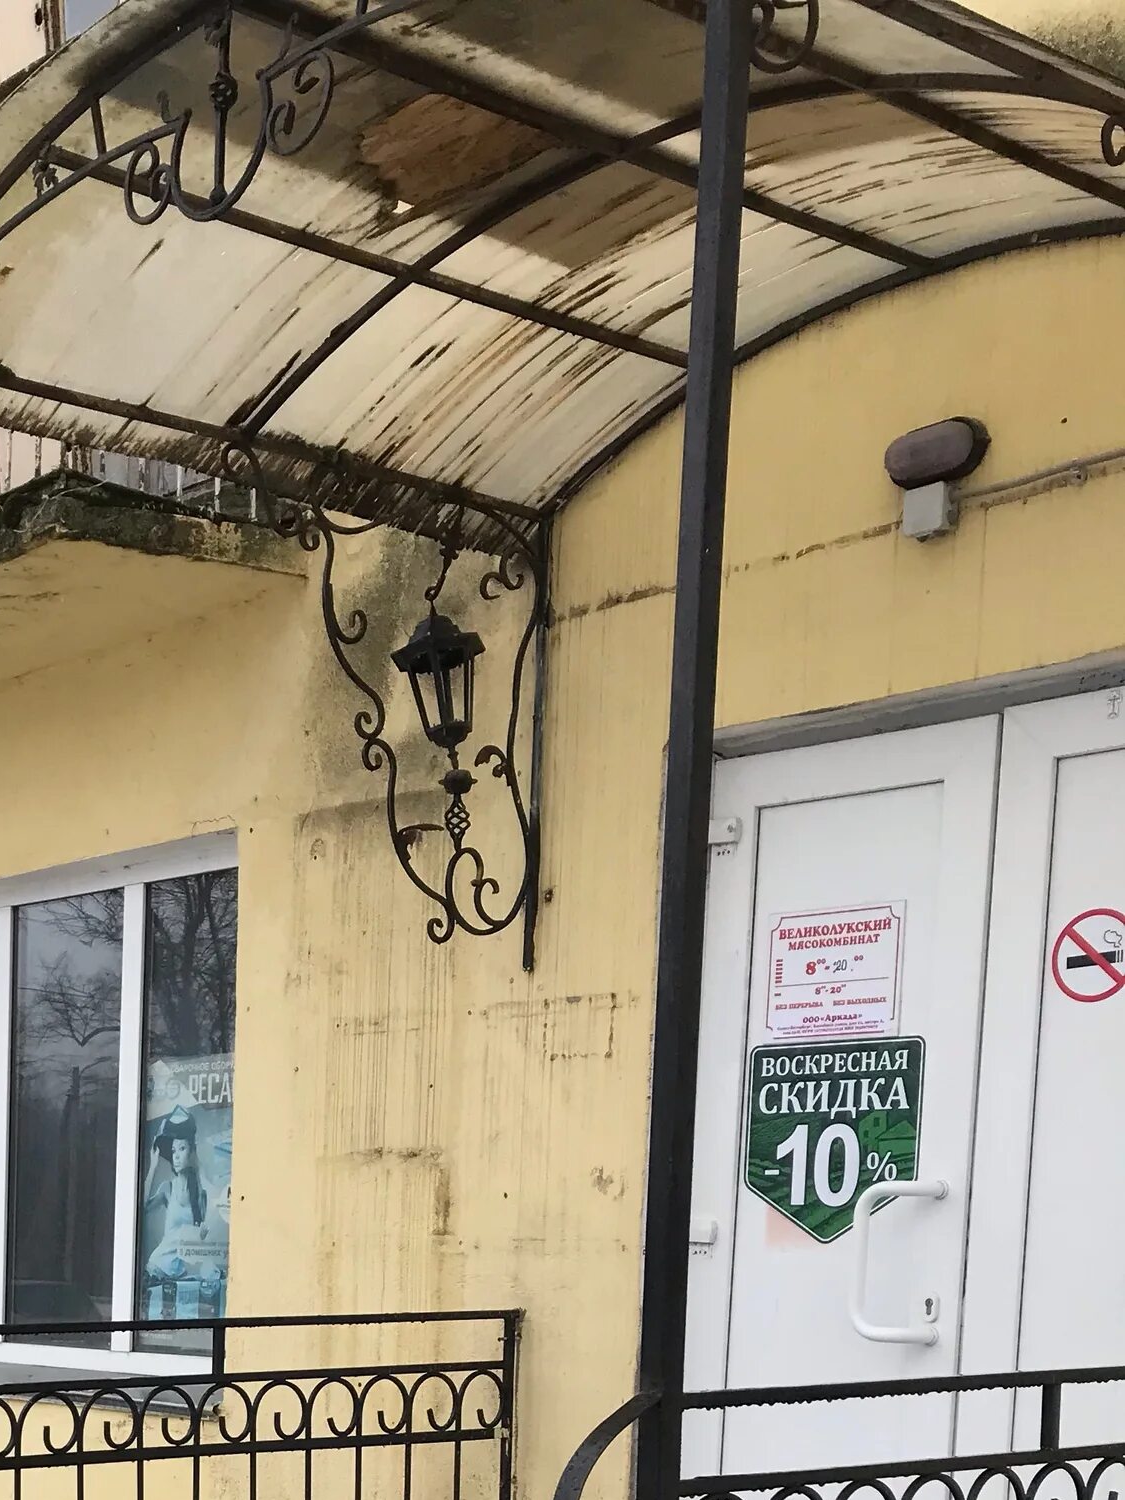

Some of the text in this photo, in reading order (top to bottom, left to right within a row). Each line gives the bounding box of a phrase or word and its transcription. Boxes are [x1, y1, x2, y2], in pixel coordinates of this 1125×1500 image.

[778, 917, 892, 940] ВЕЛИКОЛУКСКИЙ
[788, 934, 880, 951] МЯСОКОМБИНАТ
[803, 1016, 820, 1024] ООО
[761, 1049, 909, 1078] ВОСКРЕСНАЯ
[759, 1077, 910, 1119] СКИДКА
